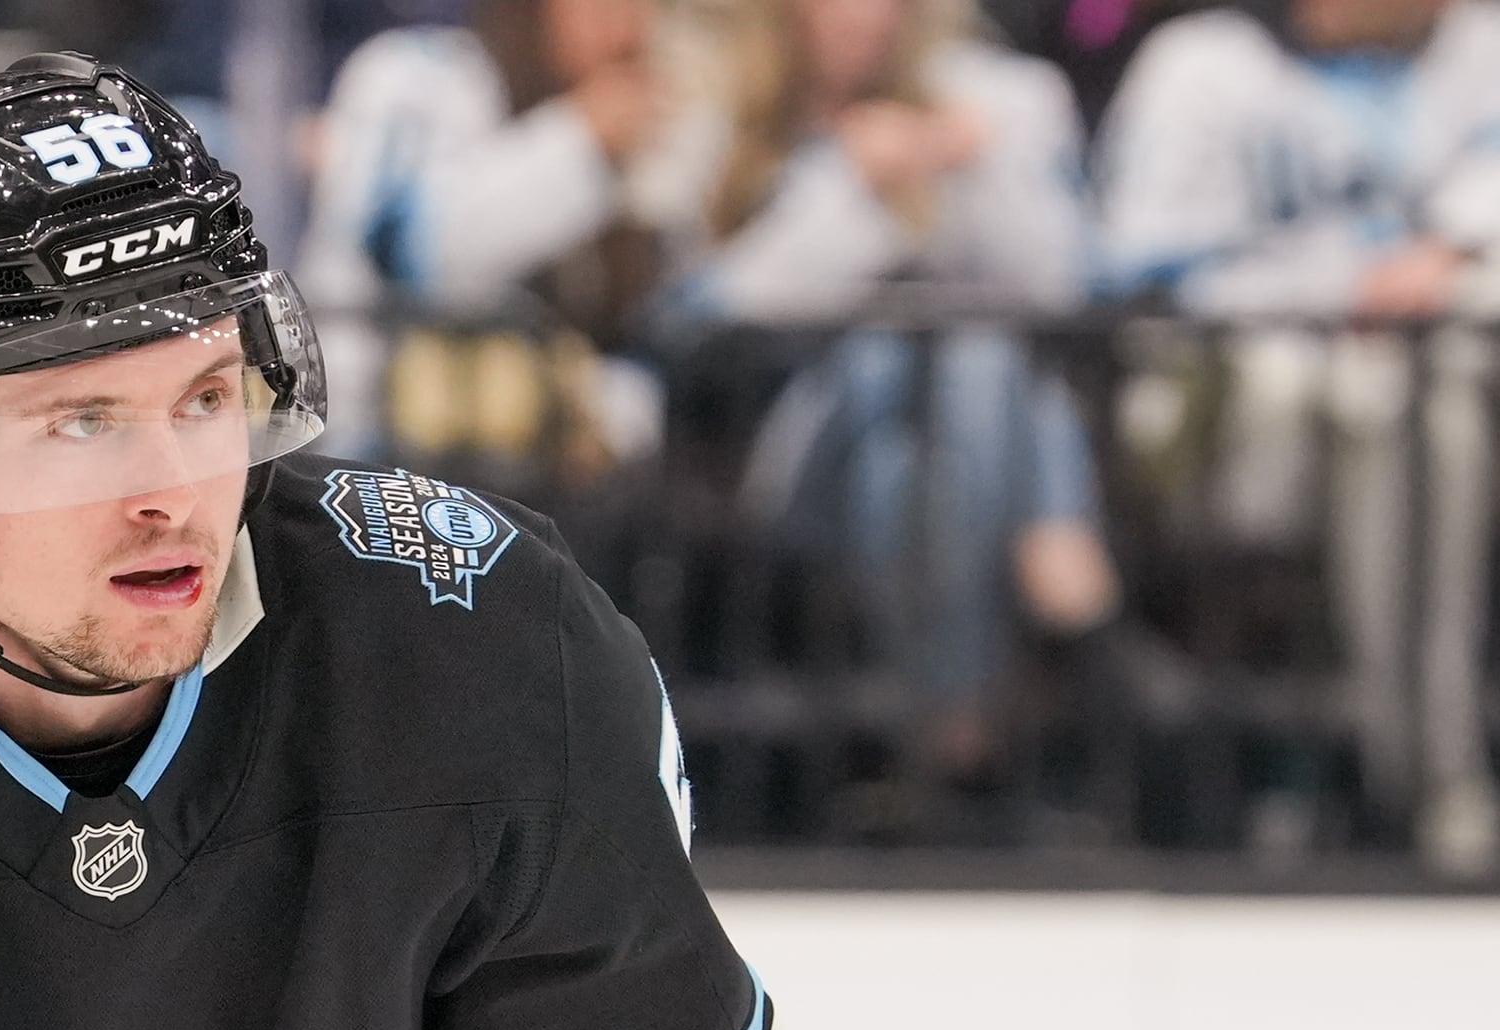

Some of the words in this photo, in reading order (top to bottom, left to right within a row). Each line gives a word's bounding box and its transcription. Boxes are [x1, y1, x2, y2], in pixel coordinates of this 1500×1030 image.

[21, 112, 153, 185] 56
[62, 216, 196, 278] CCM
[353, 476, 393, 555] INAUGURAL
[377, 477, 427, 560] SEASON
[445, 504, 475, 540] UTAH
[430, 543, 451, 580] 2024
[90, 840, 131, 882] NHL
